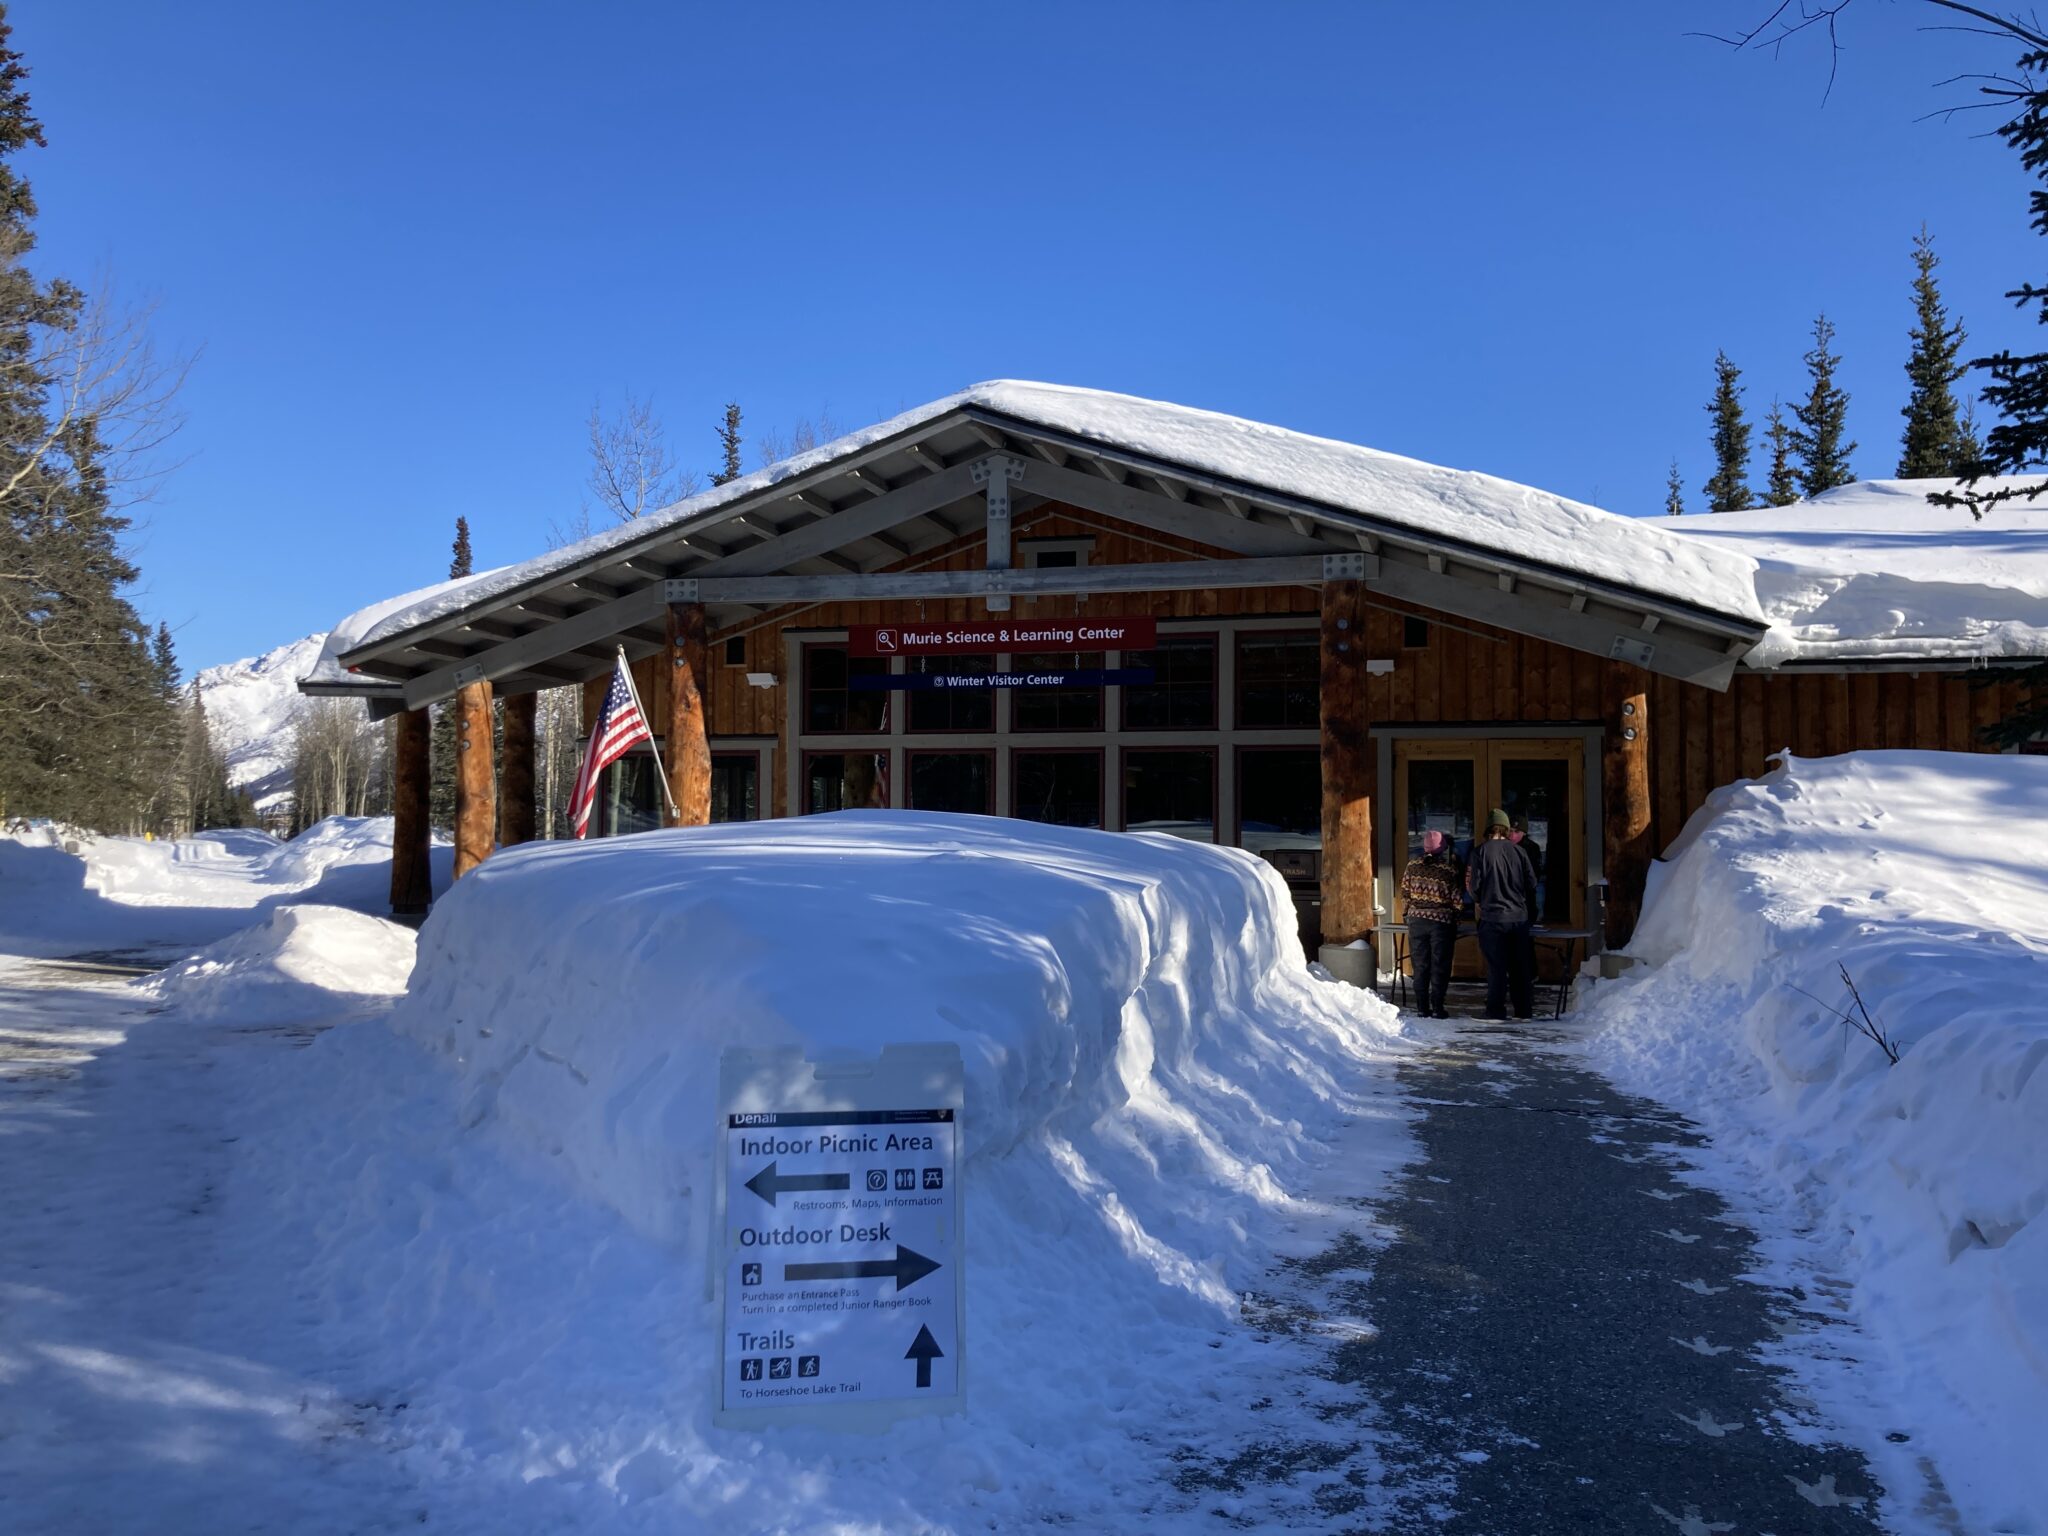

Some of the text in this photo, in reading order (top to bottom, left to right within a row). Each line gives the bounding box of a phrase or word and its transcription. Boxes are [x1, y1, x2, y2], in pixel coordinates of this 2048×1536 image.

[903, 626, 1125, 645] Murie Science & Learning Center
[947, 674, 1064, 687] Winter Visitor Center
[735, 1114, 777, 1124] Denali
[741, 1134, 933, 1156] Indoor Picnic Area
[793, 1197, 943, 1211] Restrooms, Maps, Information
[740, 1223, 891, 1246] Outdoor Desk
[742, 1292, 785, 1302] Purchase
[801, 1290, 839, 1300] Entrance
[840, 1288, 860, 1298] Pass
[742, 1305, 763, 1315] Turn
[766, 1304, 776, 1314] in
[787, 1301, 838, 1314] completed
[841, 1301, 870, 1311] Junior
[873, 1298, 905, 1312] Ranger
[908, 1297, 932, 1307] Book
[738, 1330, 795, 1351] Trails
[741, 1381, 861, 1399] To Horseshoe Lake Trail
